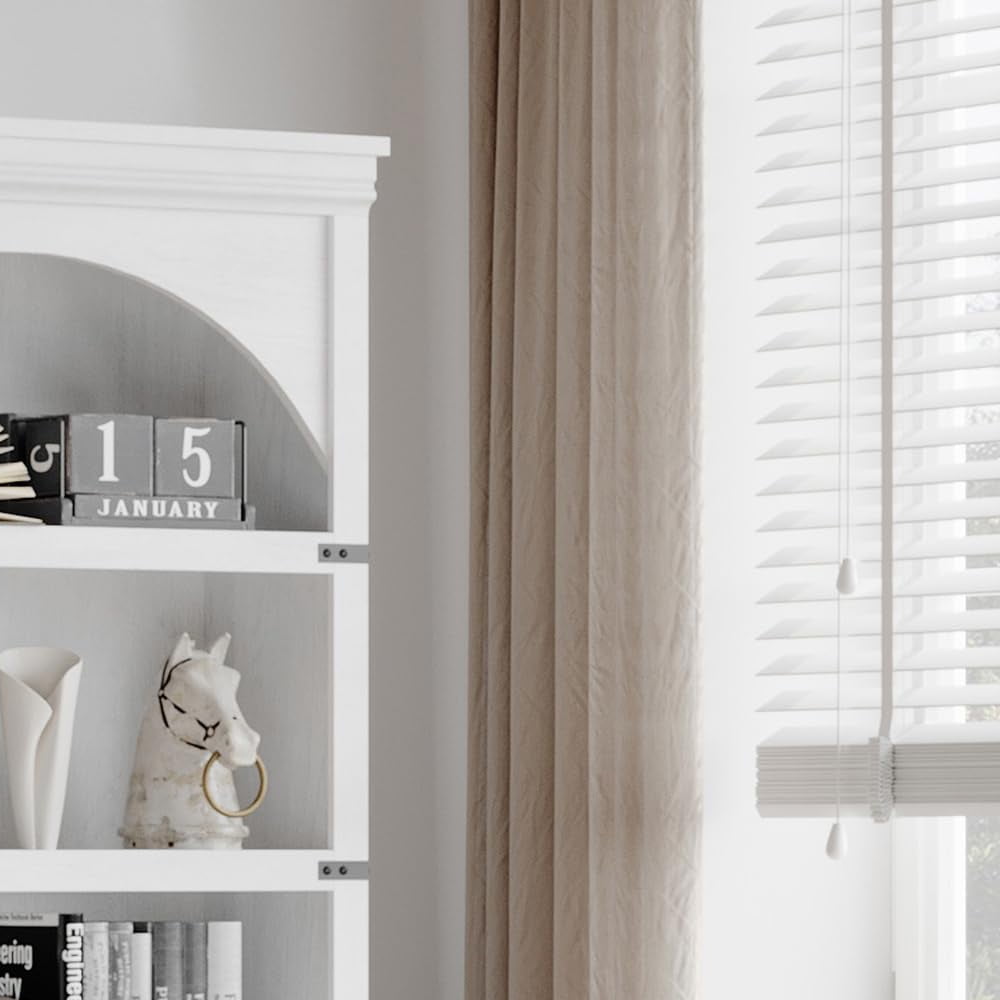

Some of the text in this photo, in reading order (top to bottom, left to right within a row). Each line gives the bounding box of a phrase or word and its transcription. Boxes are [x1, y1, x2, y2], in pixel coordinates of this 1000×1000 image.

[97, 420, 212, 488] 1 5
[97, 498, 218, 519] JANUARY
